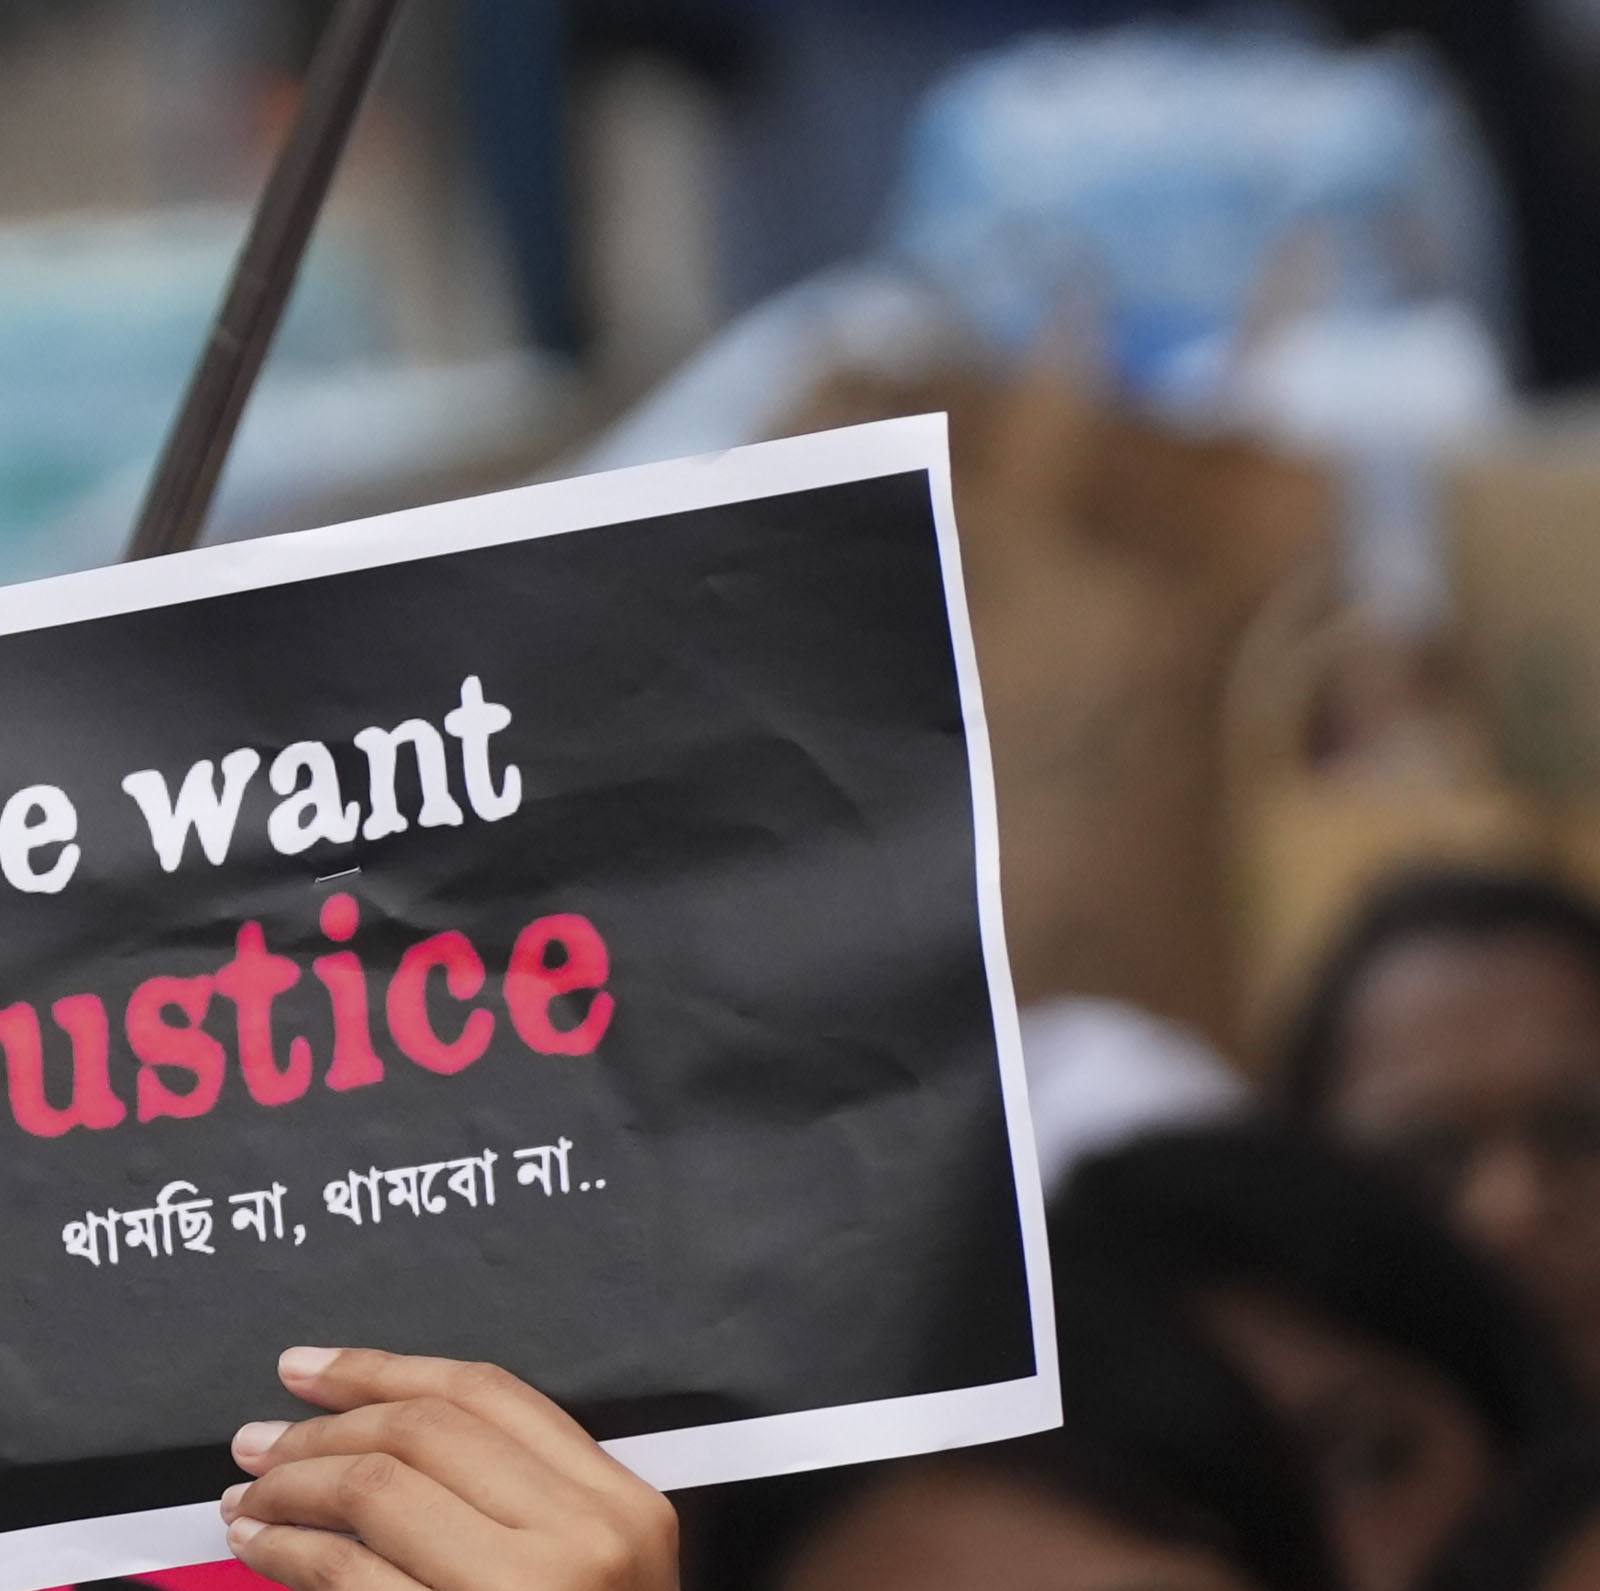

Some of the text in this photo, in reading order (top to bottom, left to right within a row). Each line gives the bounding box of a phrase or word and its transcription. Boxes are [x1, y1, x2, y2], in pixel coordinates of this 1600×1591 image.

[120, 674, 523, 874] want
[61, 1135, 607, 1267] থামছি না, থামবো না..
